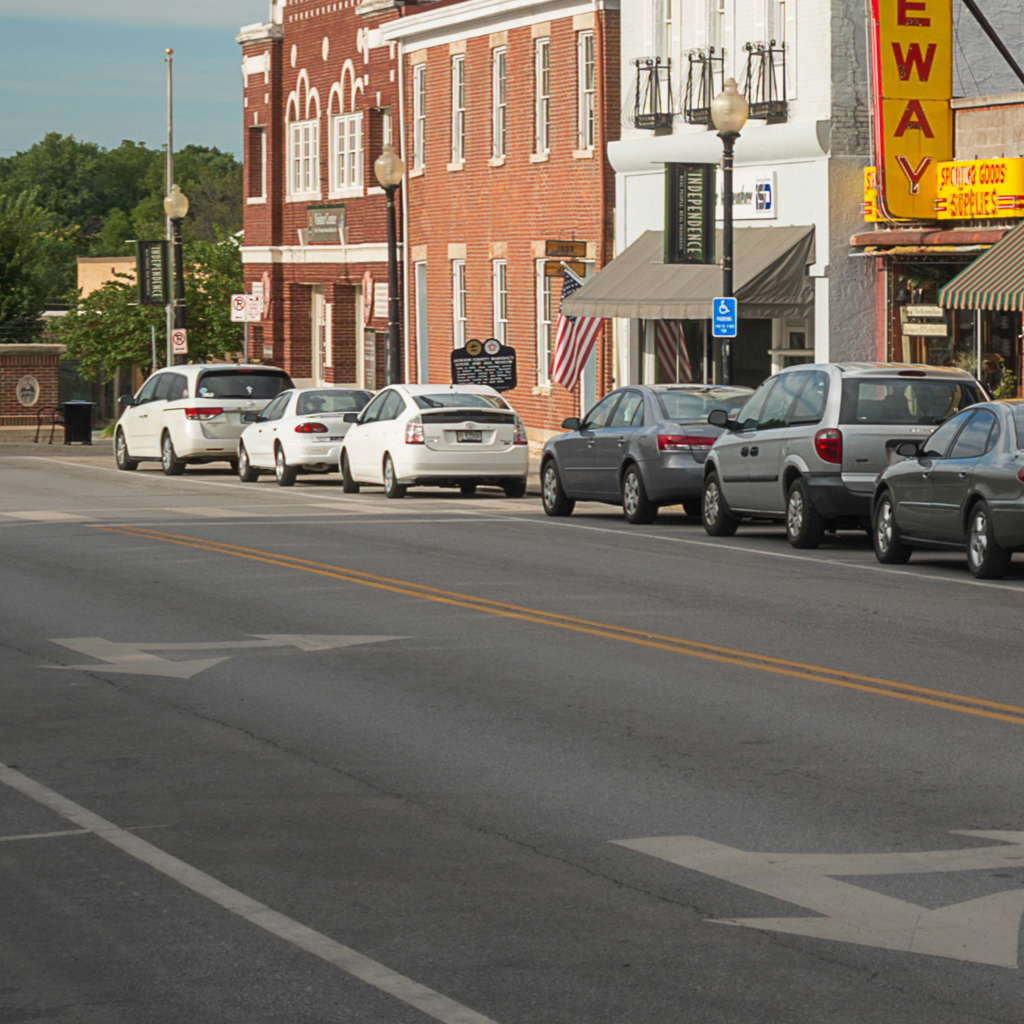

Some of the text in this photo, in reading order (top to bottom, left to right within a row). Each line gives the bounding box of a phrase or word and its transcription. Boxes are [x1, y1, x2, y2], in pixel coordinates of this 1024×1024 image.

[979, 163, 1007, 185] GOODS
[687, 173, 703, 254] INDEPENDENCE
[950, 190, 997, 217] SUPPLIES
[150, 246, 163, 298] INDEPENDENCE
